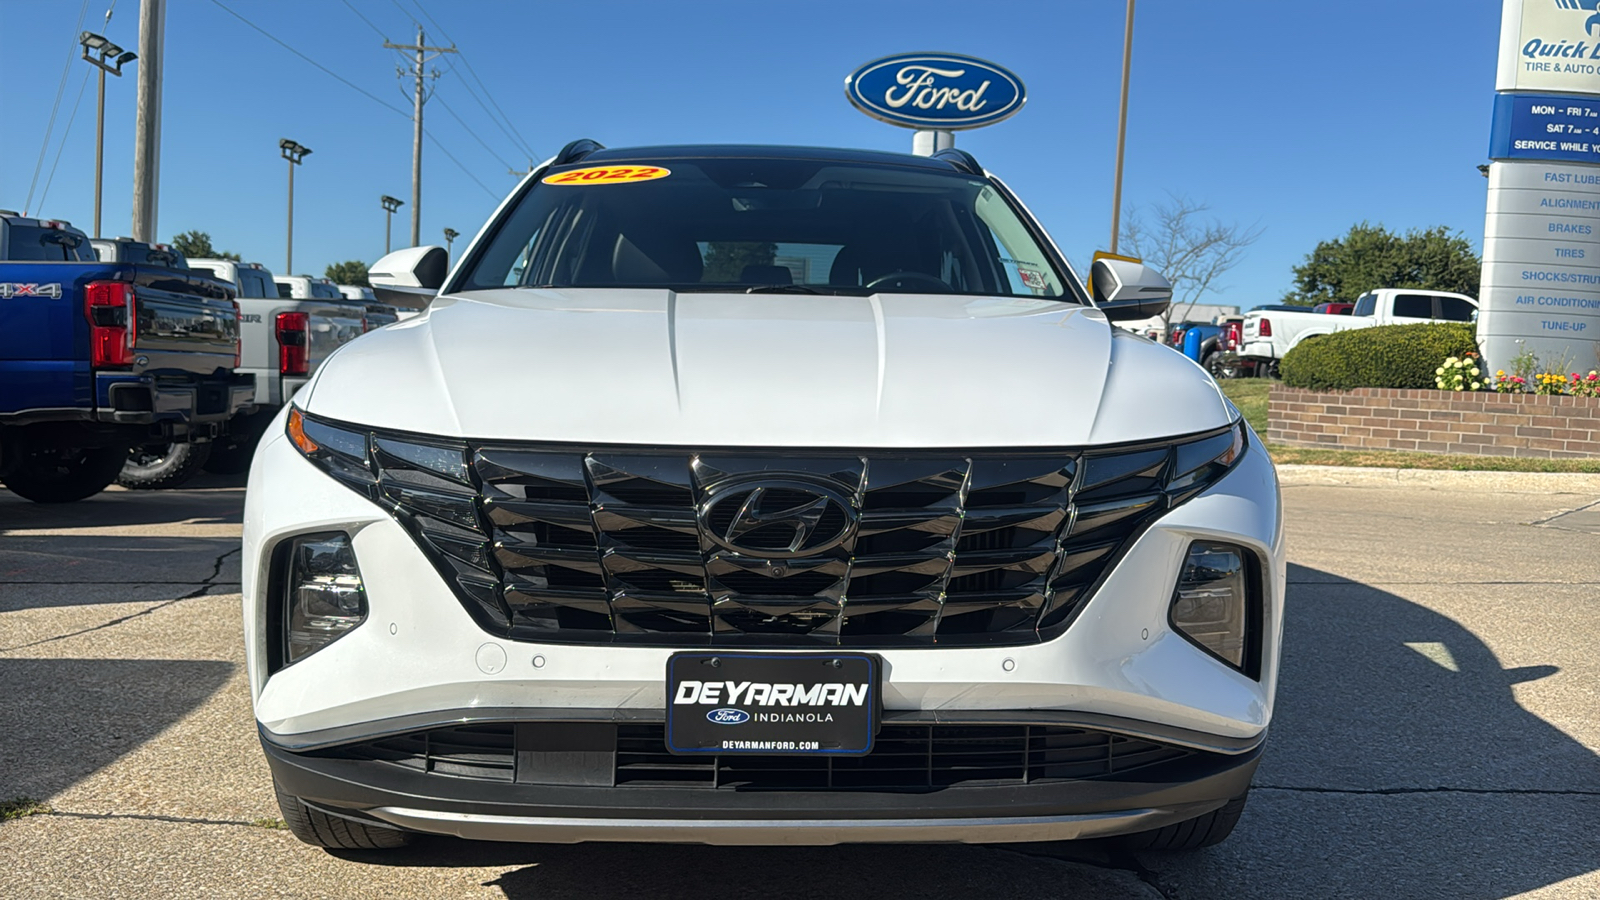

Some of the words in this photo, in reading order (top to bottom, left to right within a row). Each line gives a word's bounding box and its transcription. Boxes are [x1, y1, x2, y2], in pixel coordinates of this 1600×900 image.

[1522, 38, 1589, 58] Quick
[1525, 62, 1551, 72] TIRE
[1553, 63, 1561, 73] &
[1564, 63, 1595, 75] AUTO
[885, 65, 991, 112] Ford
[1531, 105, 1555, 115] MON
[1566, 107, 1582, 117] FRI
[1546, 123, 1565, 134] SAT
[1514, 140, 1557, 151] SERVICE
[1560, 142, 1589, 152] WHILE
[553, 168, 660, 183] 2022
[1544, 172, 1572, 183] FAST
[1574, 174, 1600, 185] LUBE
[1540, 198, 1600, 210] ALIGNMENT
[1548, 223, 1592, 235] BRAKES
[1555, 248, 1585, 259] TIRES
[1516, 295, 1535, 305] AIR
[1541, 321, 1587, 331] TUNE-UP
[673, 680, 869, 707] DEYARMAN
[754, 713, 833, 723] INDIANOLA
[722, 740, 819, 750] DEYARMANFORD.COM
